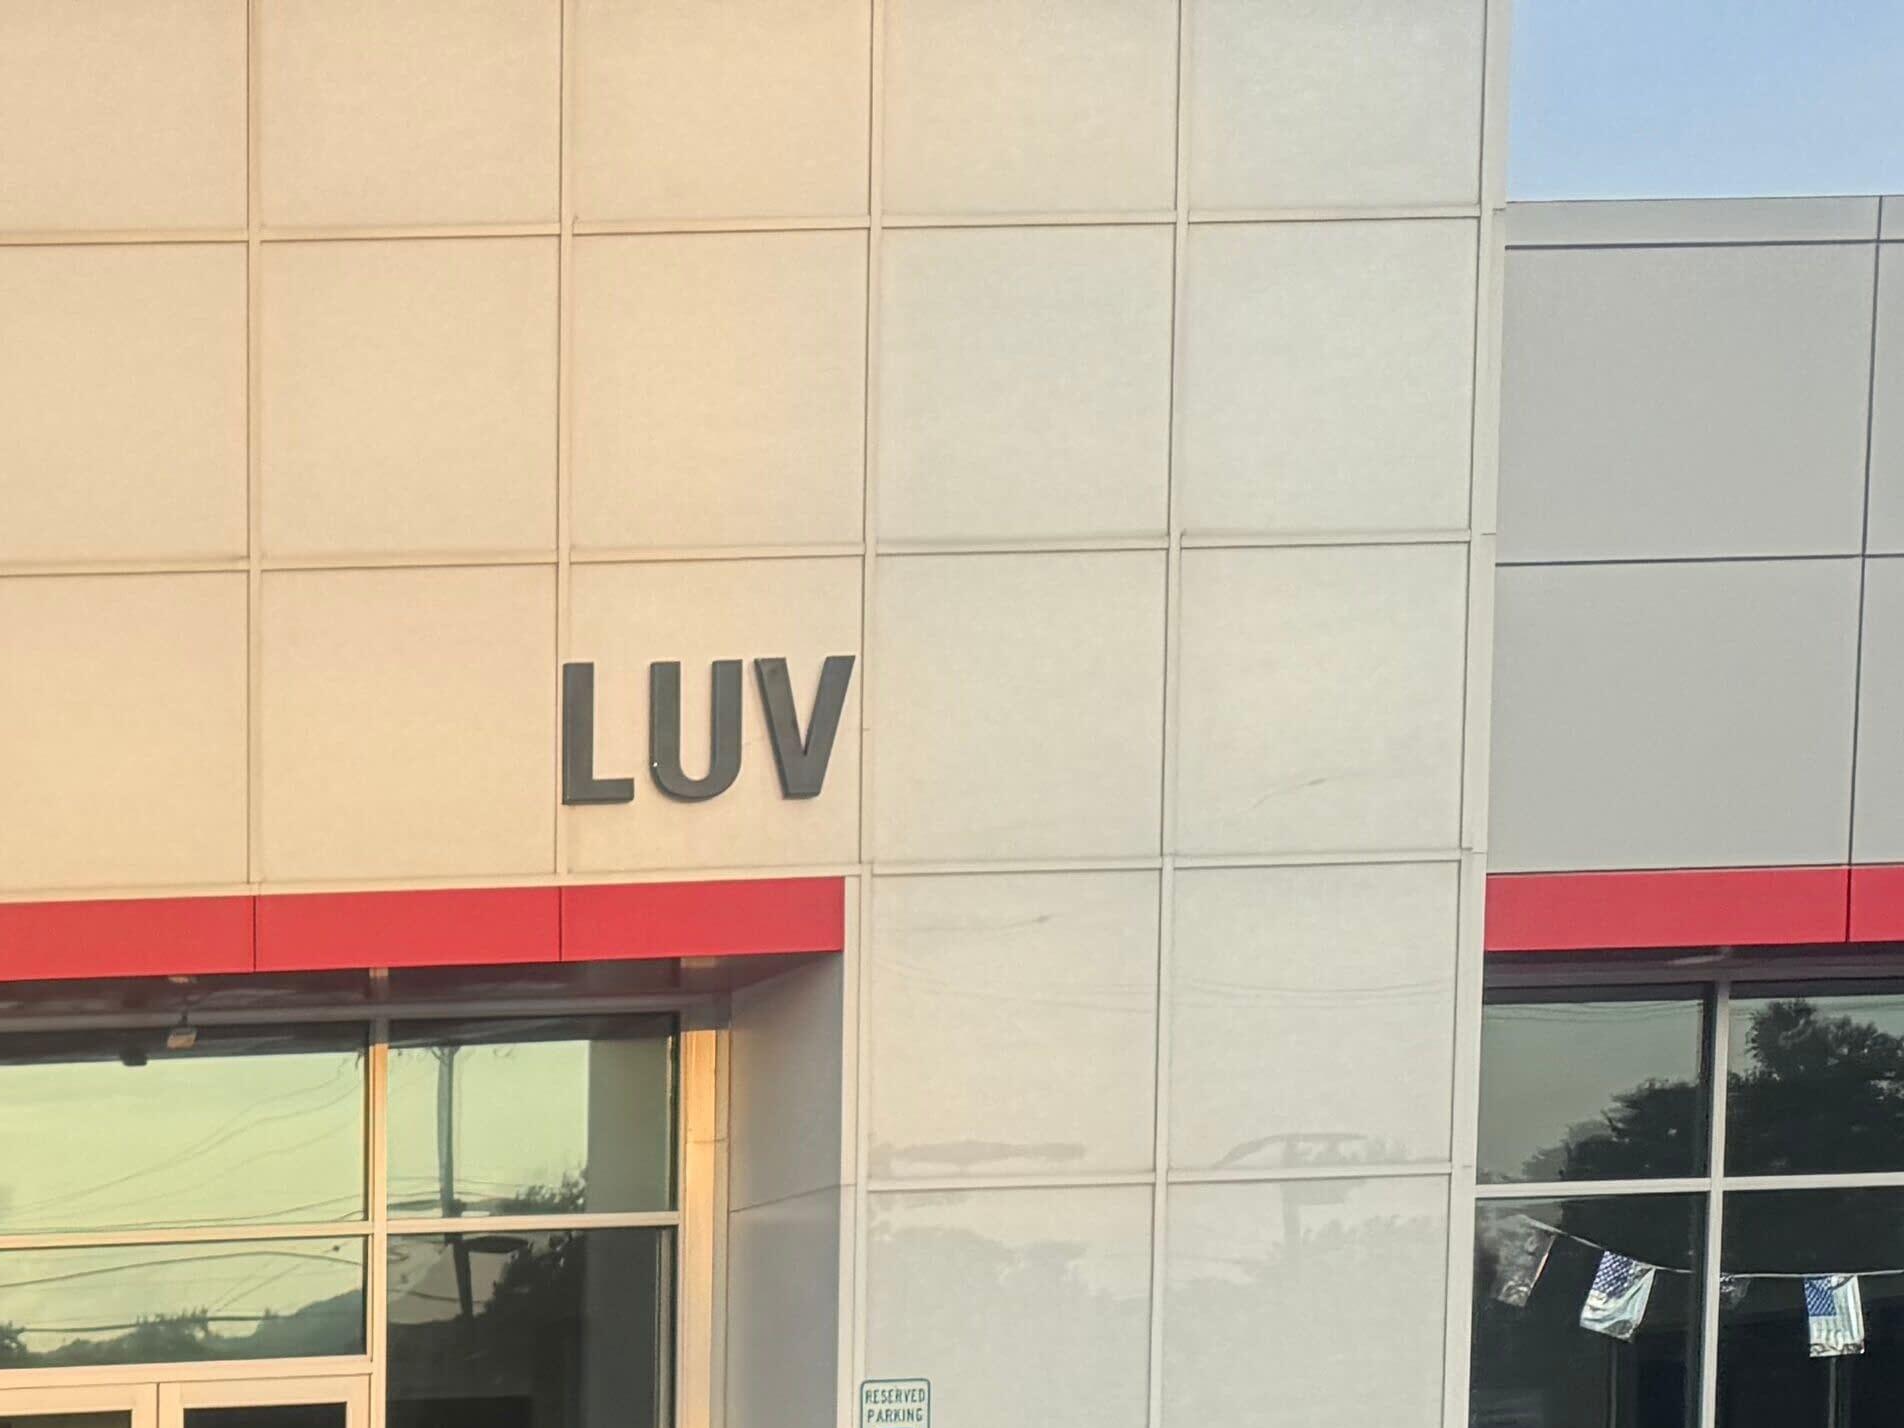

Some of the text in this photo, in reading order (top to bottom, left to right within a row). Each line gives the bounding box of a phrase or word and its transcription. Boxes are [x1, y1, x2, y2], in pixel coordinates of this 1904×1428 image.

[562, 655, 856, 805] LUV
[864, 1388, 926, 1404] RESERVED
[867, 1408, 923, 1423] PARKING
